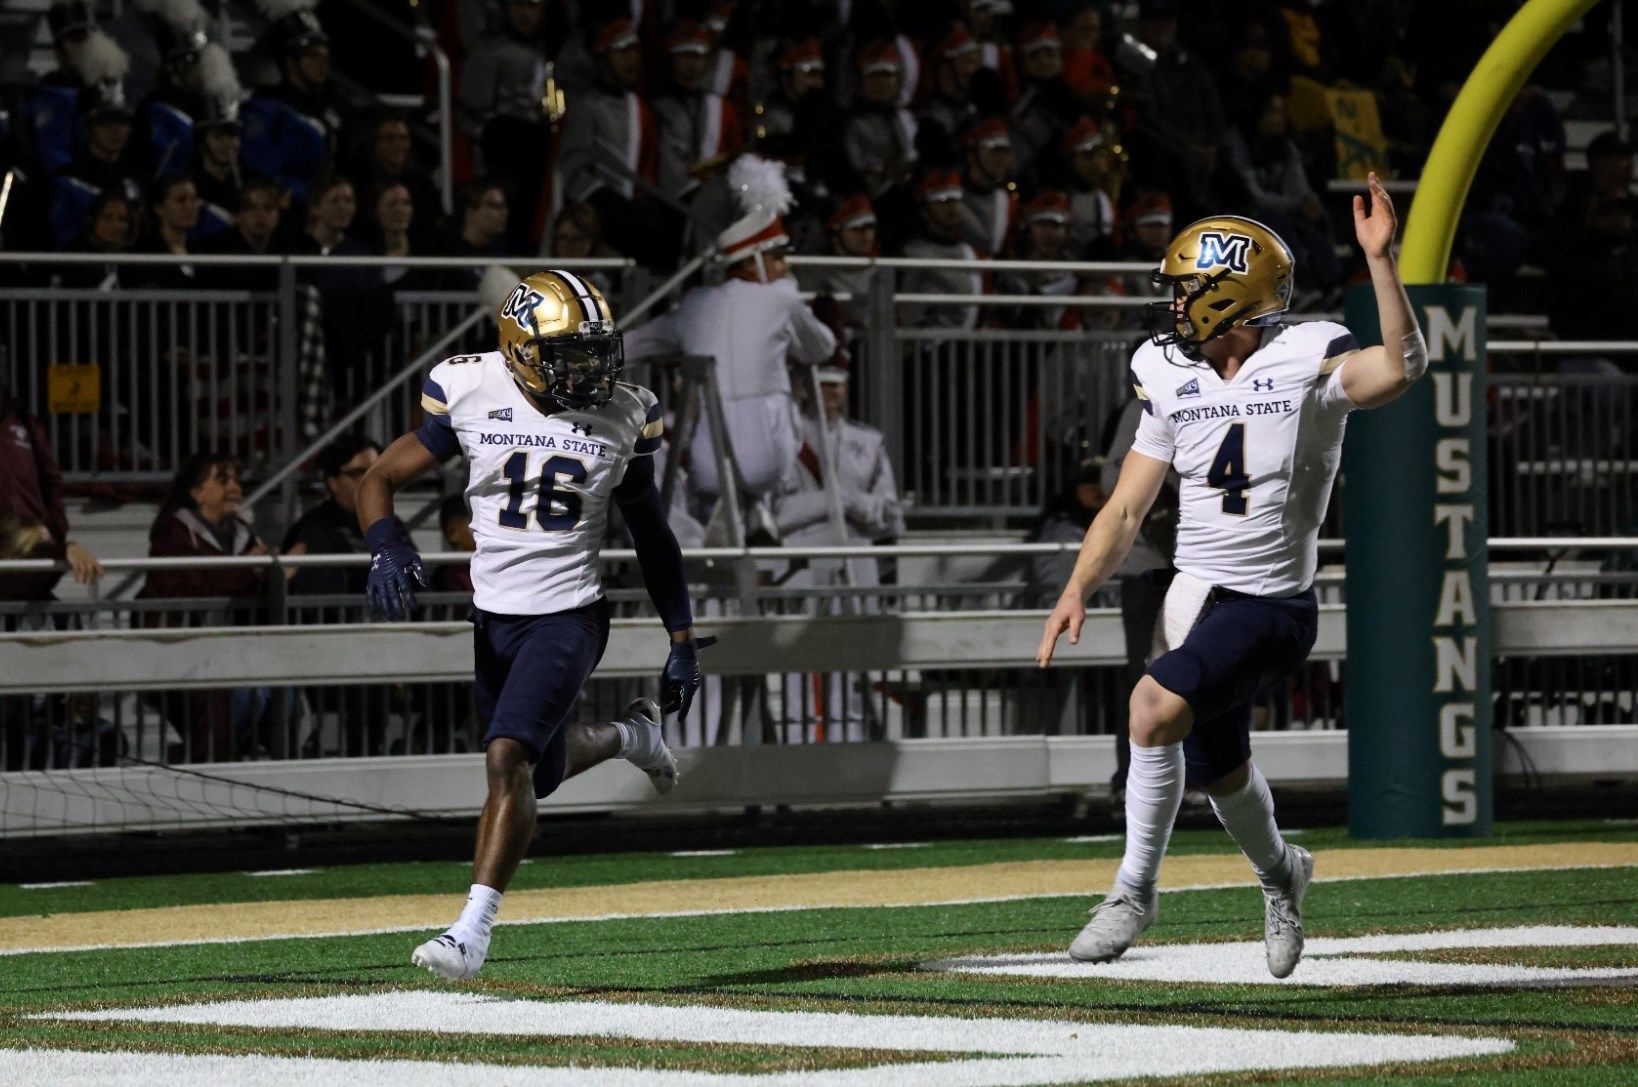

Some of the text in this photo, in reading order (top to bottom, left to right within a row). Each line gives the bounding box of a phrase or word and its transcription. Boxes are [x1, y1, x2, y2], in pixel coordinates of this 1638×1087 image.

[480, 433, 607, 457] MONTANA STATE
[1173, 400, 1292, 423] MONTANA STATE
[499, 450, 589, 532] 16
[1207, 420, 1250, 517] 4
[1424, 305, 1477, 825] MUSTANGS
